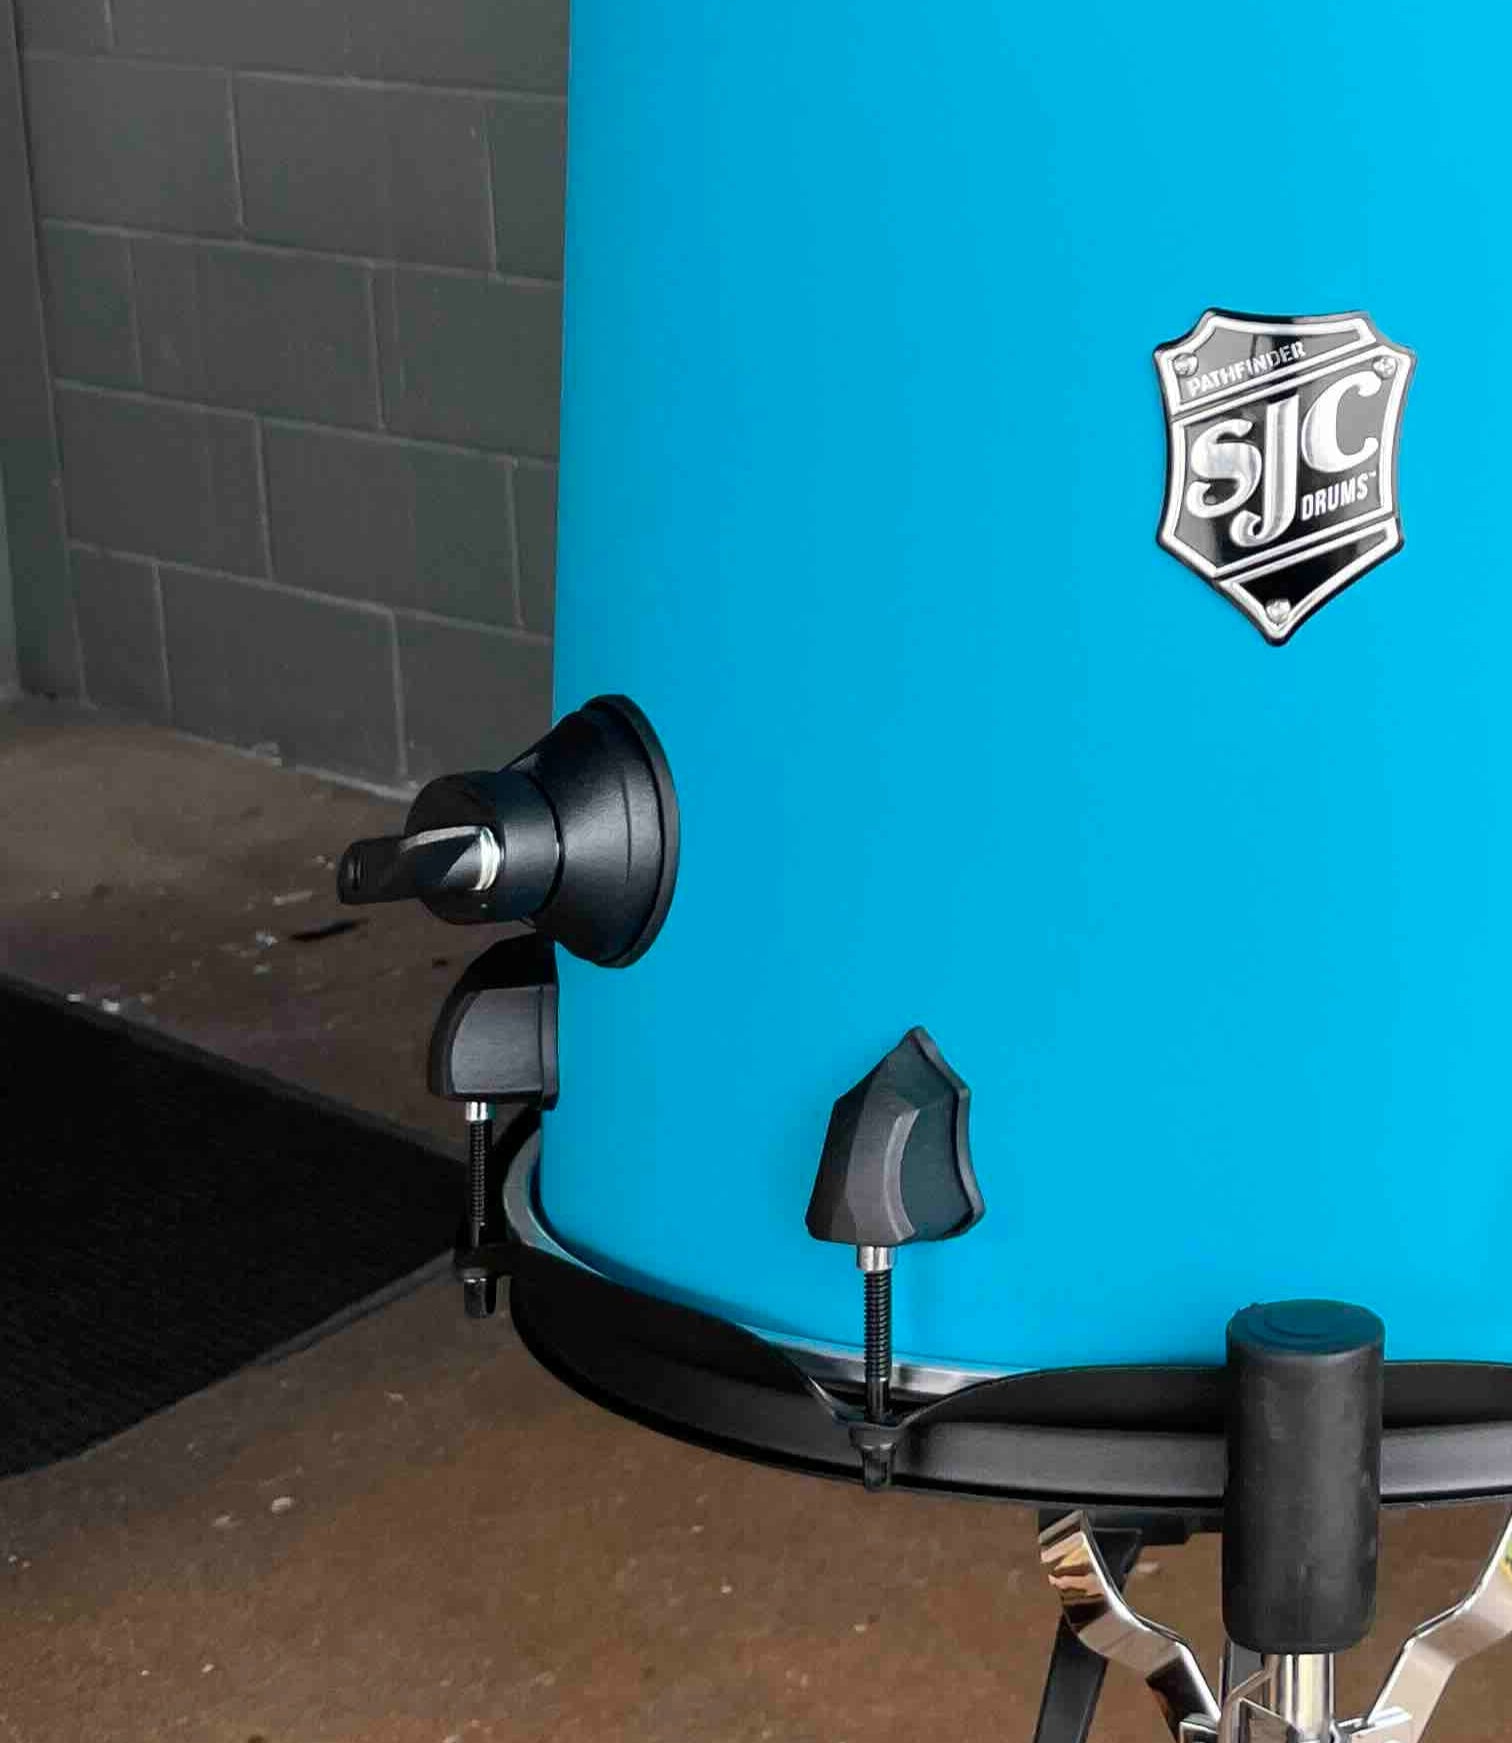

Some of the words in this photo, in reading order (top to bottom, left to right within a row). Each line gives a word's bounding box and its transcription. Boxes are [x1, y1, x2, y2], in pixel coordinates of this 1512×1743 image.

[1186, 341, 1307, 397] PATHFINDER
[1186, 370, 1382, 548] SJC
[1301, 472, 1369, 521] DRUMS
